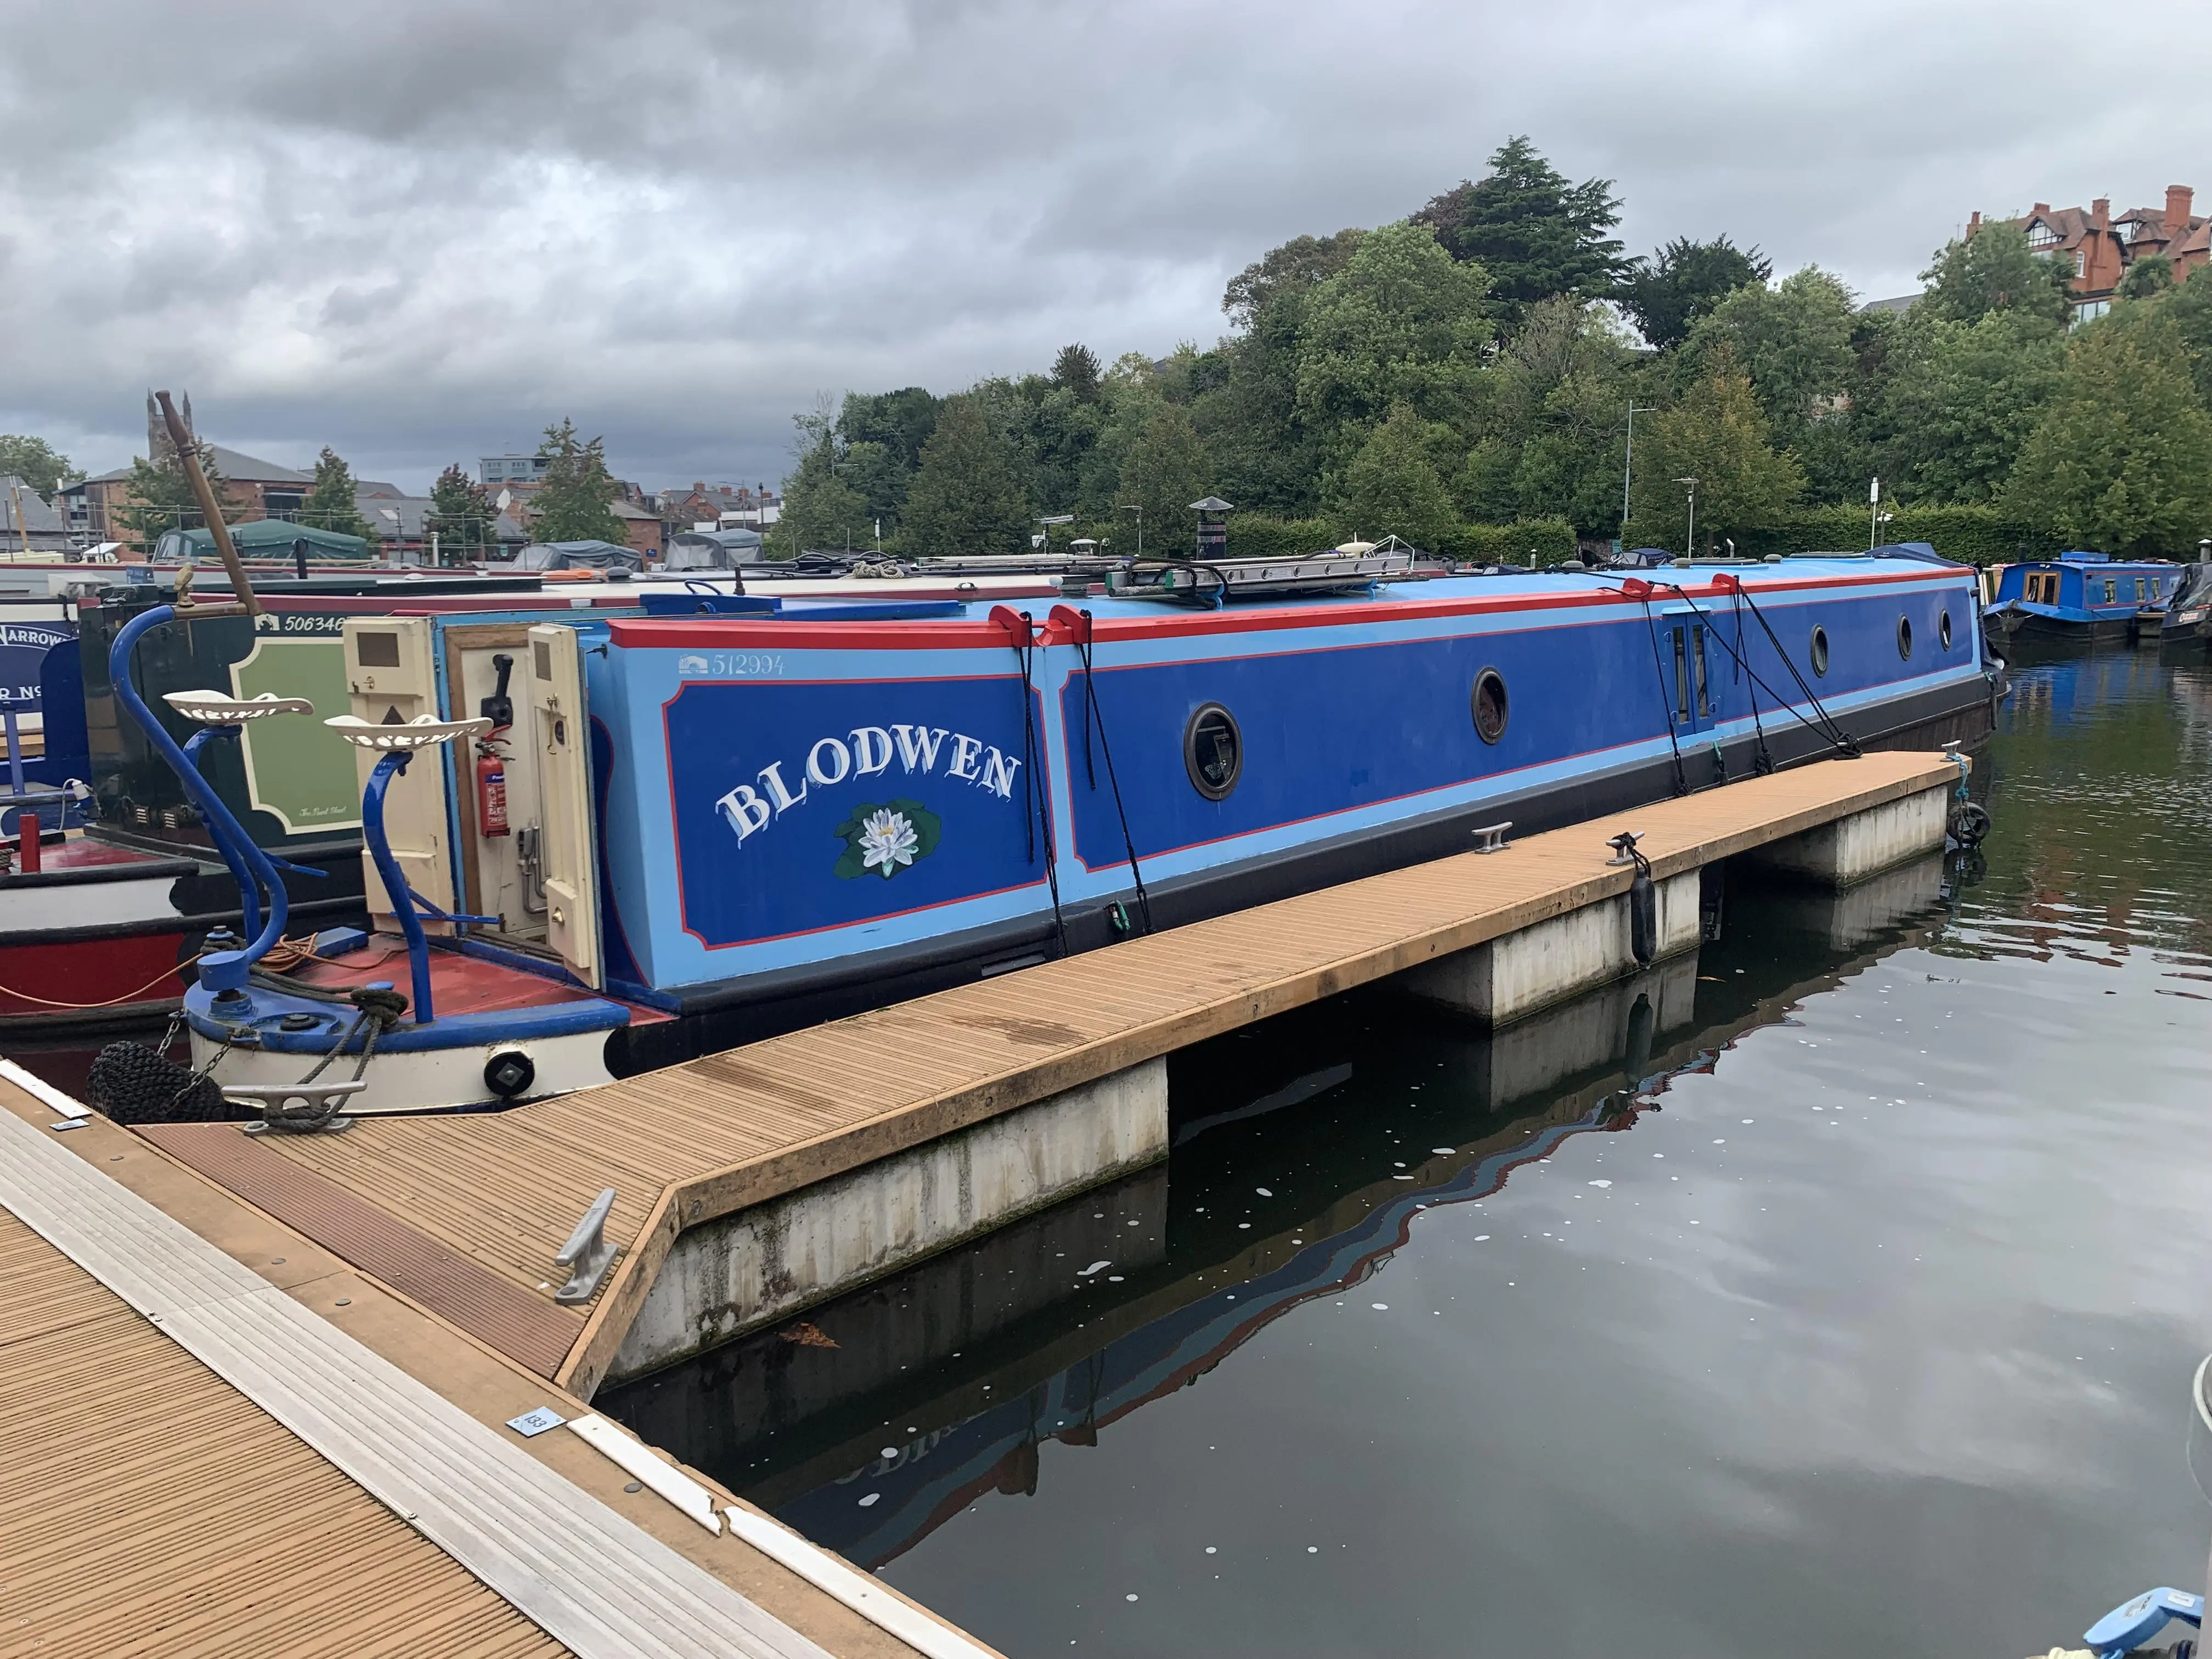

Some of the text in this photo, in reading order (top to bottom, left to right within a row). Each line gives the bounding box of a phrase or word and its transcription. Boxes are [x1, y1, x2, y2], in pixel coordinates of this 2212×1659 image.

[285, 616, 345, 631] 506346
[0, 625, 66, 646] NARROW
[713, 654, 785, 675] 512994
[715, 724, 1022, 850] BLODWEN
[524, 1414, 547, 1427] 133
